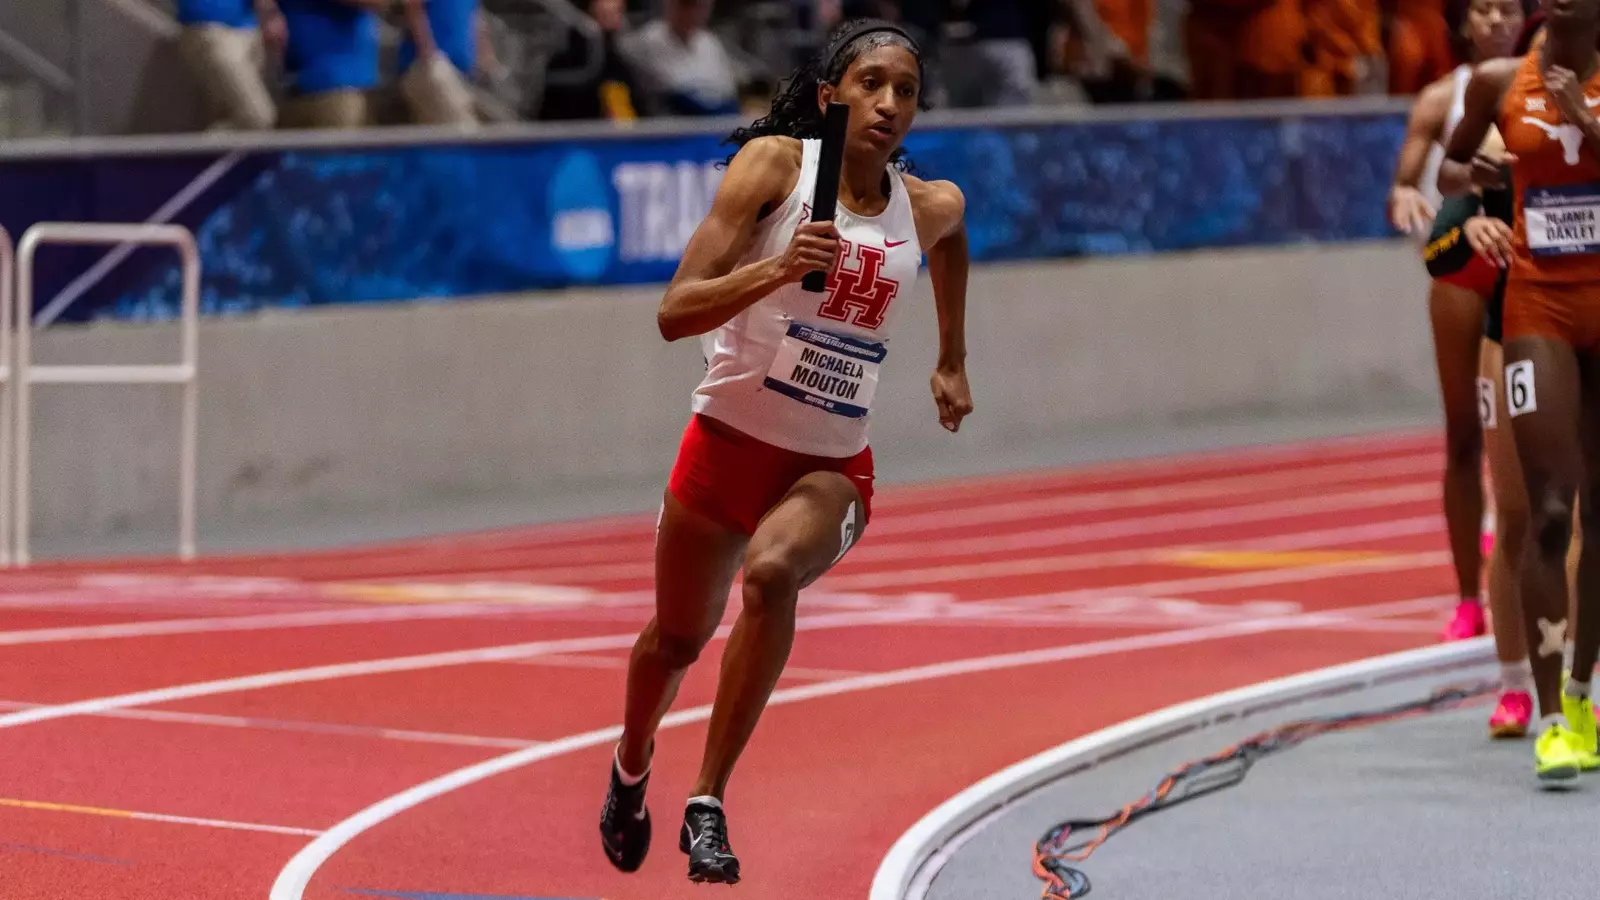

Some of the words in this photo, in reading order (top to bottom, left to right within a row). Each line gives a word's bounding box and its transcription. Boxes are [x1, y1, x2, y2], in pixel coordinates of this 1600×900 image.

[800, 347, 864, 380] MICHAELA
[790, 364, 860, 400] MOUTON
[1511, 367, 1528, 409] 6
